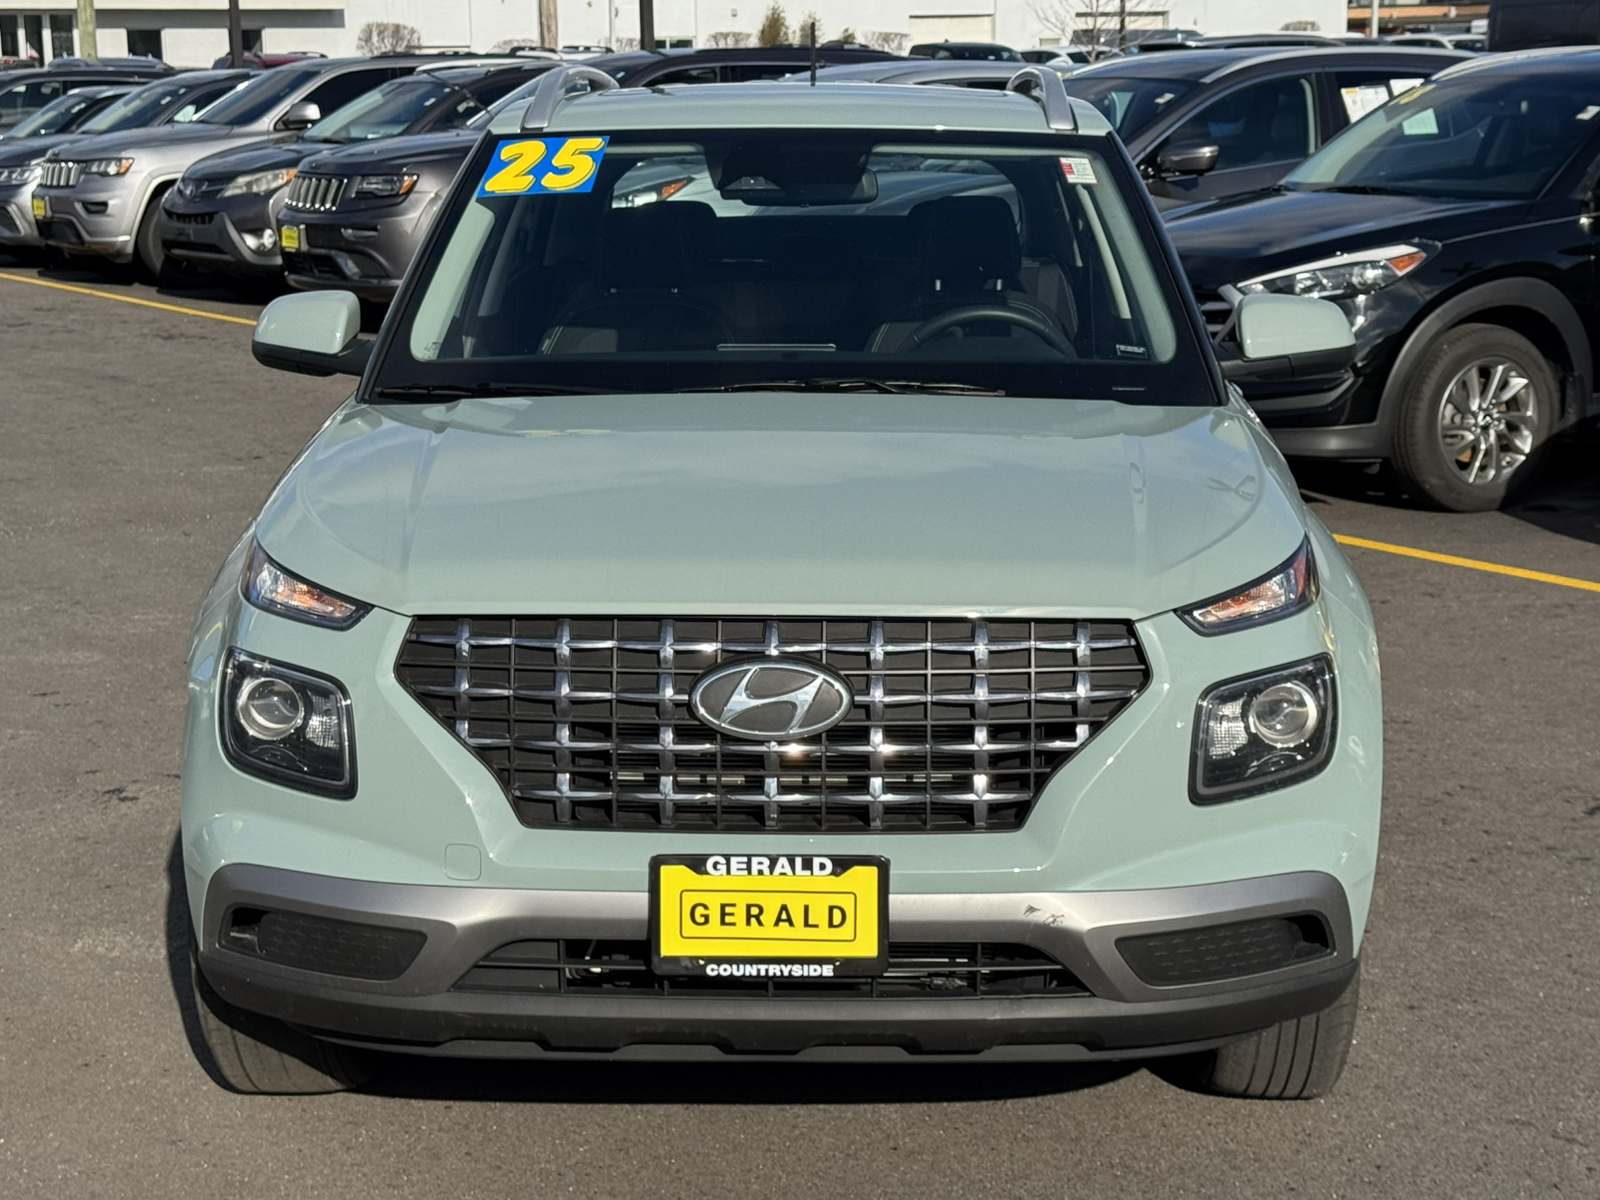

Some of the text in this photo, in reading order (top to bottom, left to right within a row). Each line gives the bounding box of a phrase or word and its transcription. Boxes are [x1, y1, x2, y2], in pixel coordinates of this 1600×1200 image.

[485, 137, 605, 194] 25
[705, 855, 834, 876] GERALD
[689, 902, 848, 929] GERALD
[705, 964, 835, 977] COUNTRYSIDE
